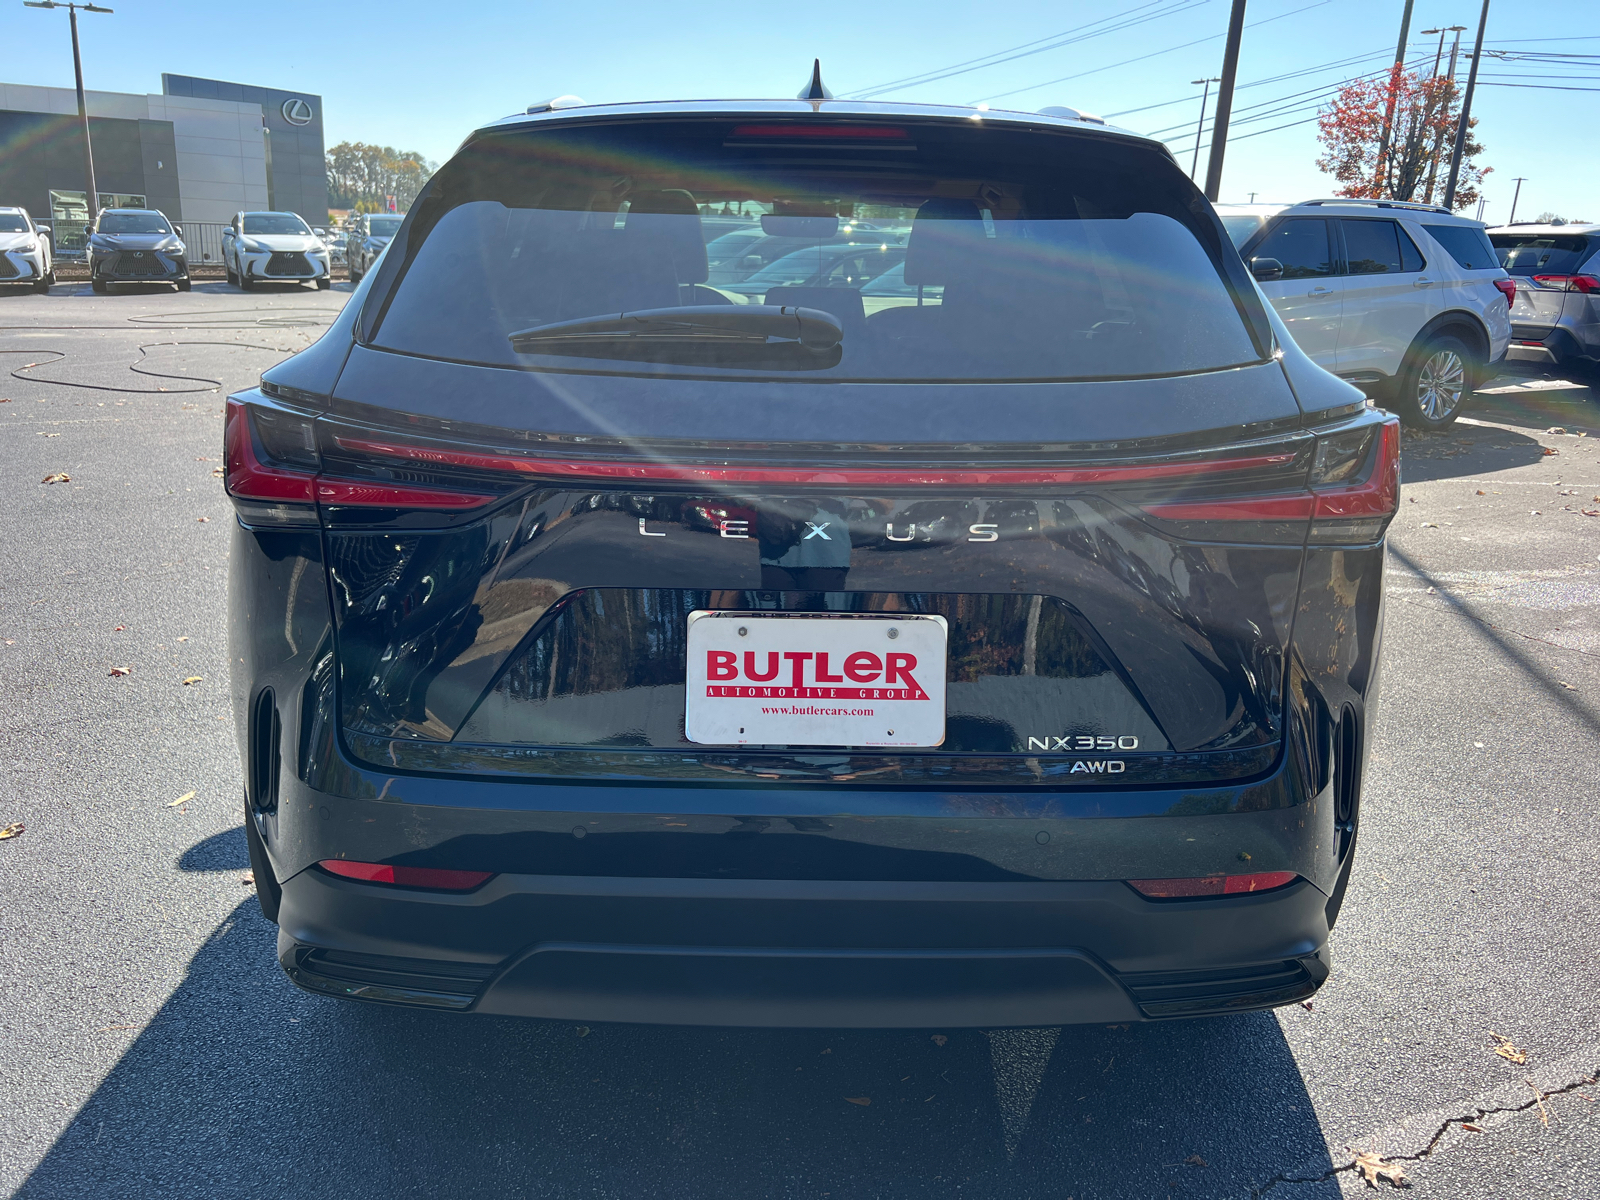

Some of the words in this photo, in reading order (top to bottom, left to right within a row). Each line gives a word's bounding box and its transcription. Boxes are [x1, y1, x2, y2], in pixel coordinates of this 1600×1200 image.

[638, 517, 999, 542] LEXUS
[707, 686, 837, 698] AUTOMOTIVE
[859, 689, 924, 700] GROUP
[761, 705, 874, 717] www.butlercars.com
[1069, 760, 1126, 774] AWD
